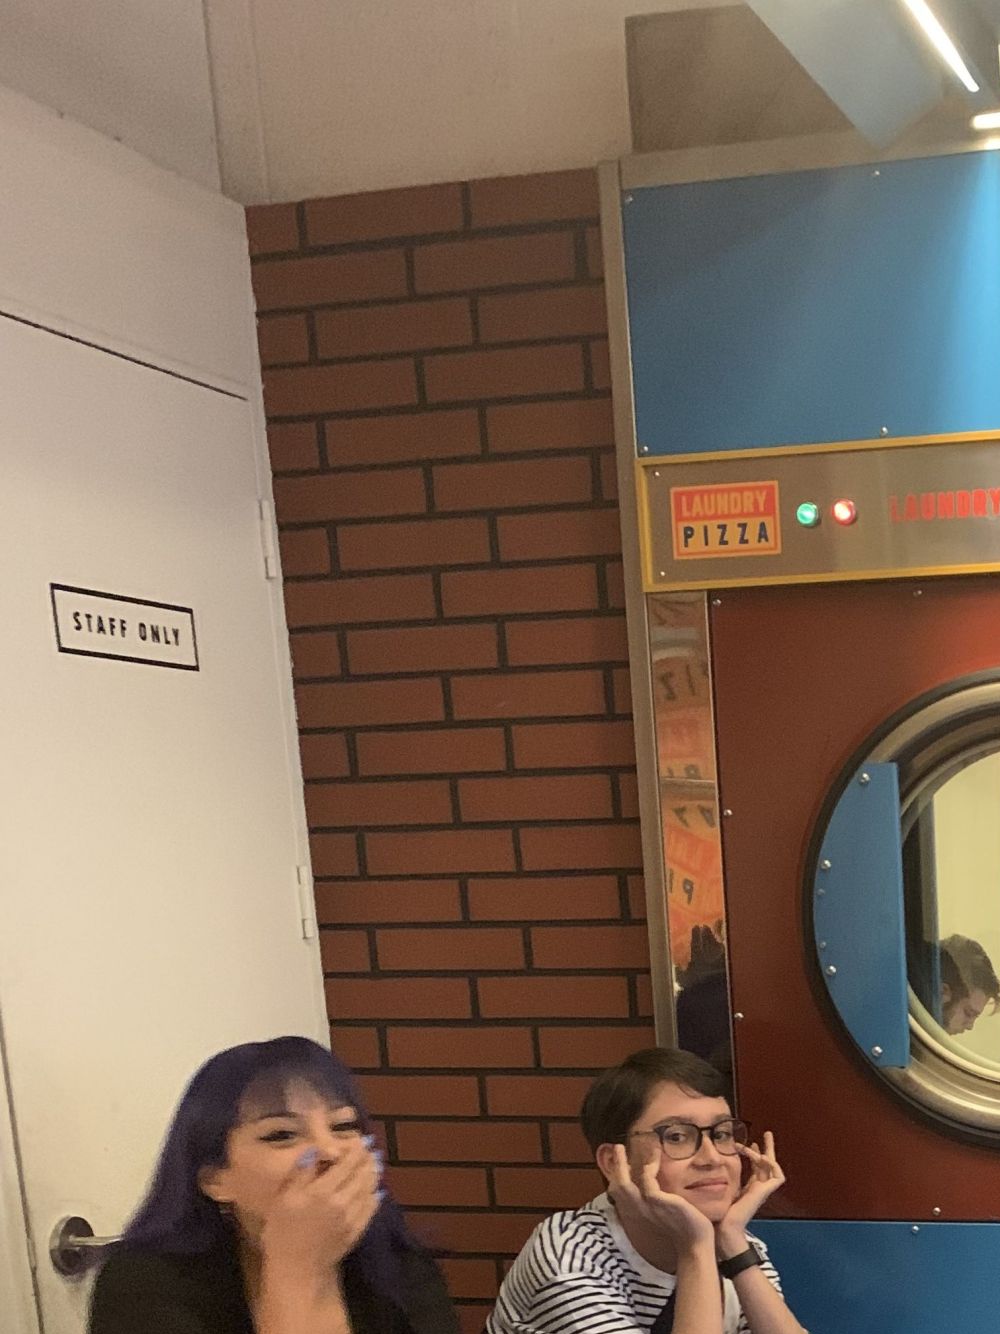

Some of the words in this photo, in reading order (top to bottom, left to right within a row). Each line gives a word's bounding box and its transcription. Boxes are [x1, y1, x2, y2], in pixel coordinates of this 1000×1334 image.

[681, 489, 768, 518] LAUNDRY
[683, 521, 769, 548] PIZZA
[73, 611, 127, 638] STAFF
[138, 622, 180, 646] ONLY
